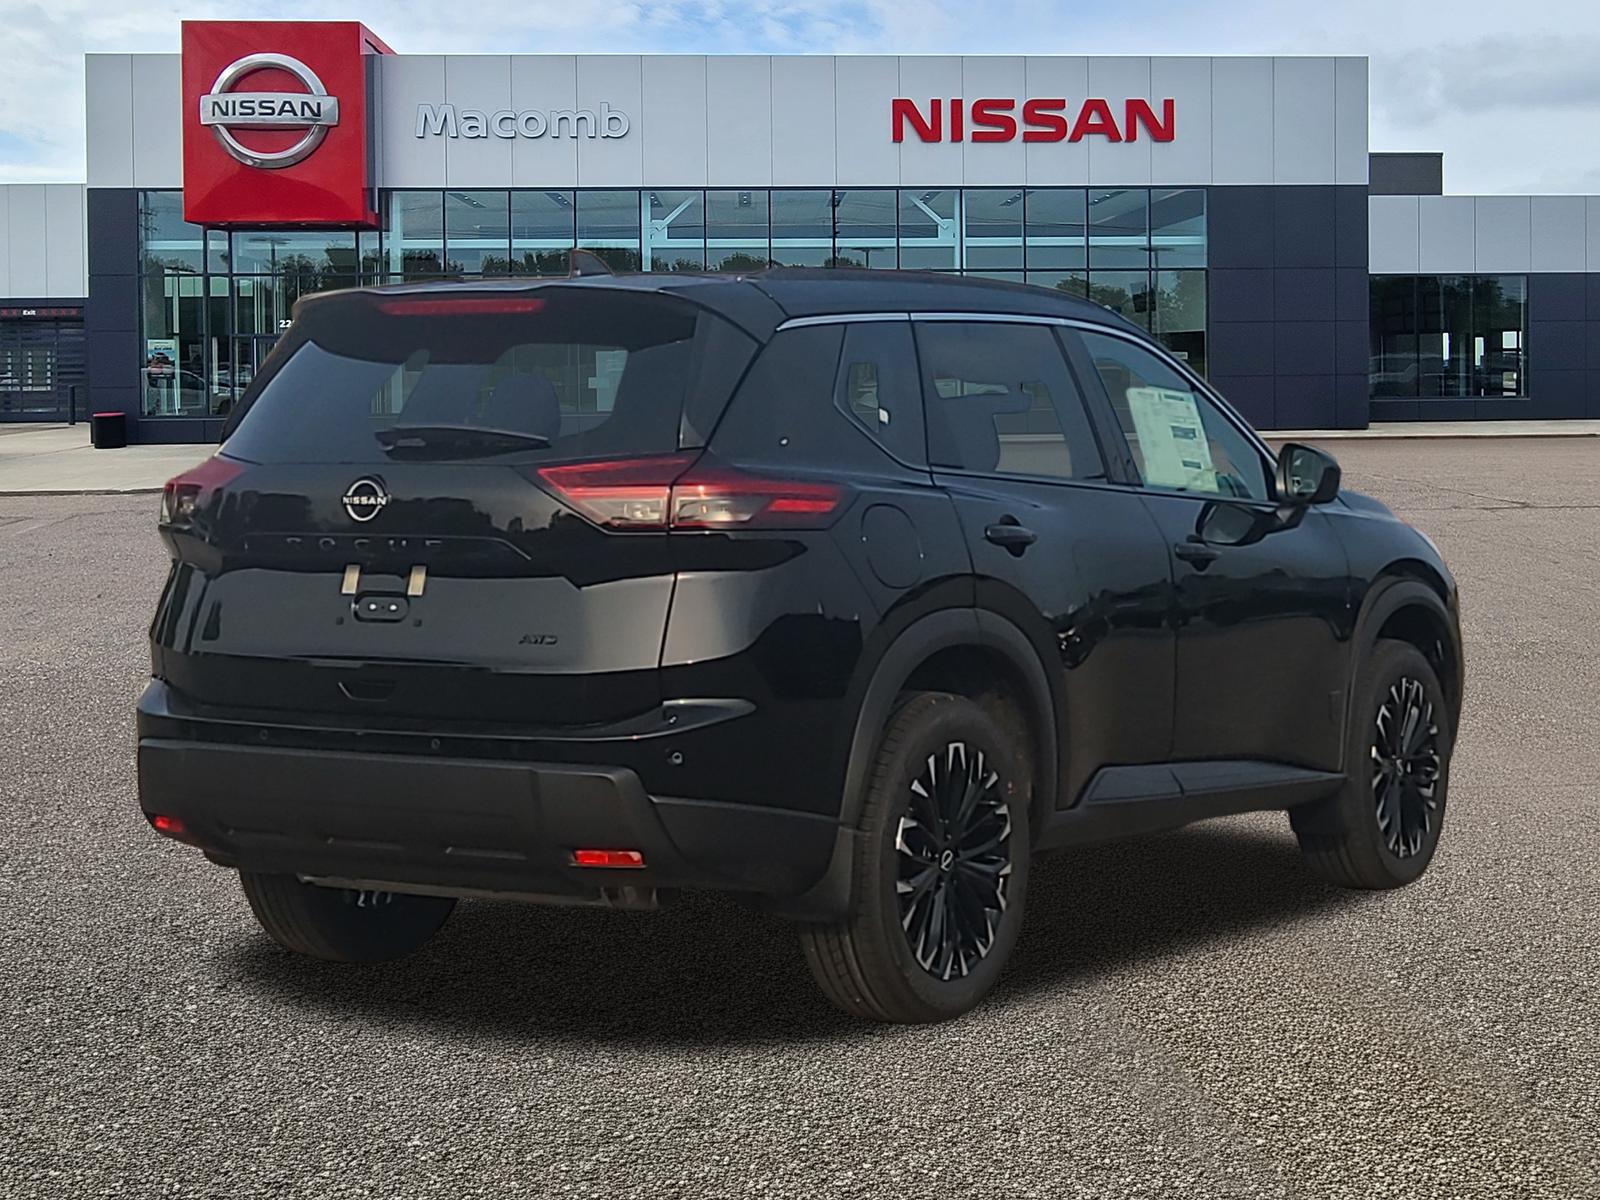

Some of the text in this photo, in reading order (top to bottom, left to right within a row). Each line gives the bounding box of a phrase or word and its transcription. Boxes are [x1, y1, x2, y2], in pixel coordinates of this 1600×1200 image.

[211, 99, 322, 118] NISSAN
[415, 101, 630, 138] Macomb
[891, 98, 1176, 143] NISSAN
[342, 496, 387, 505] NISSAN
[518, 634, 558, 645] AWD
